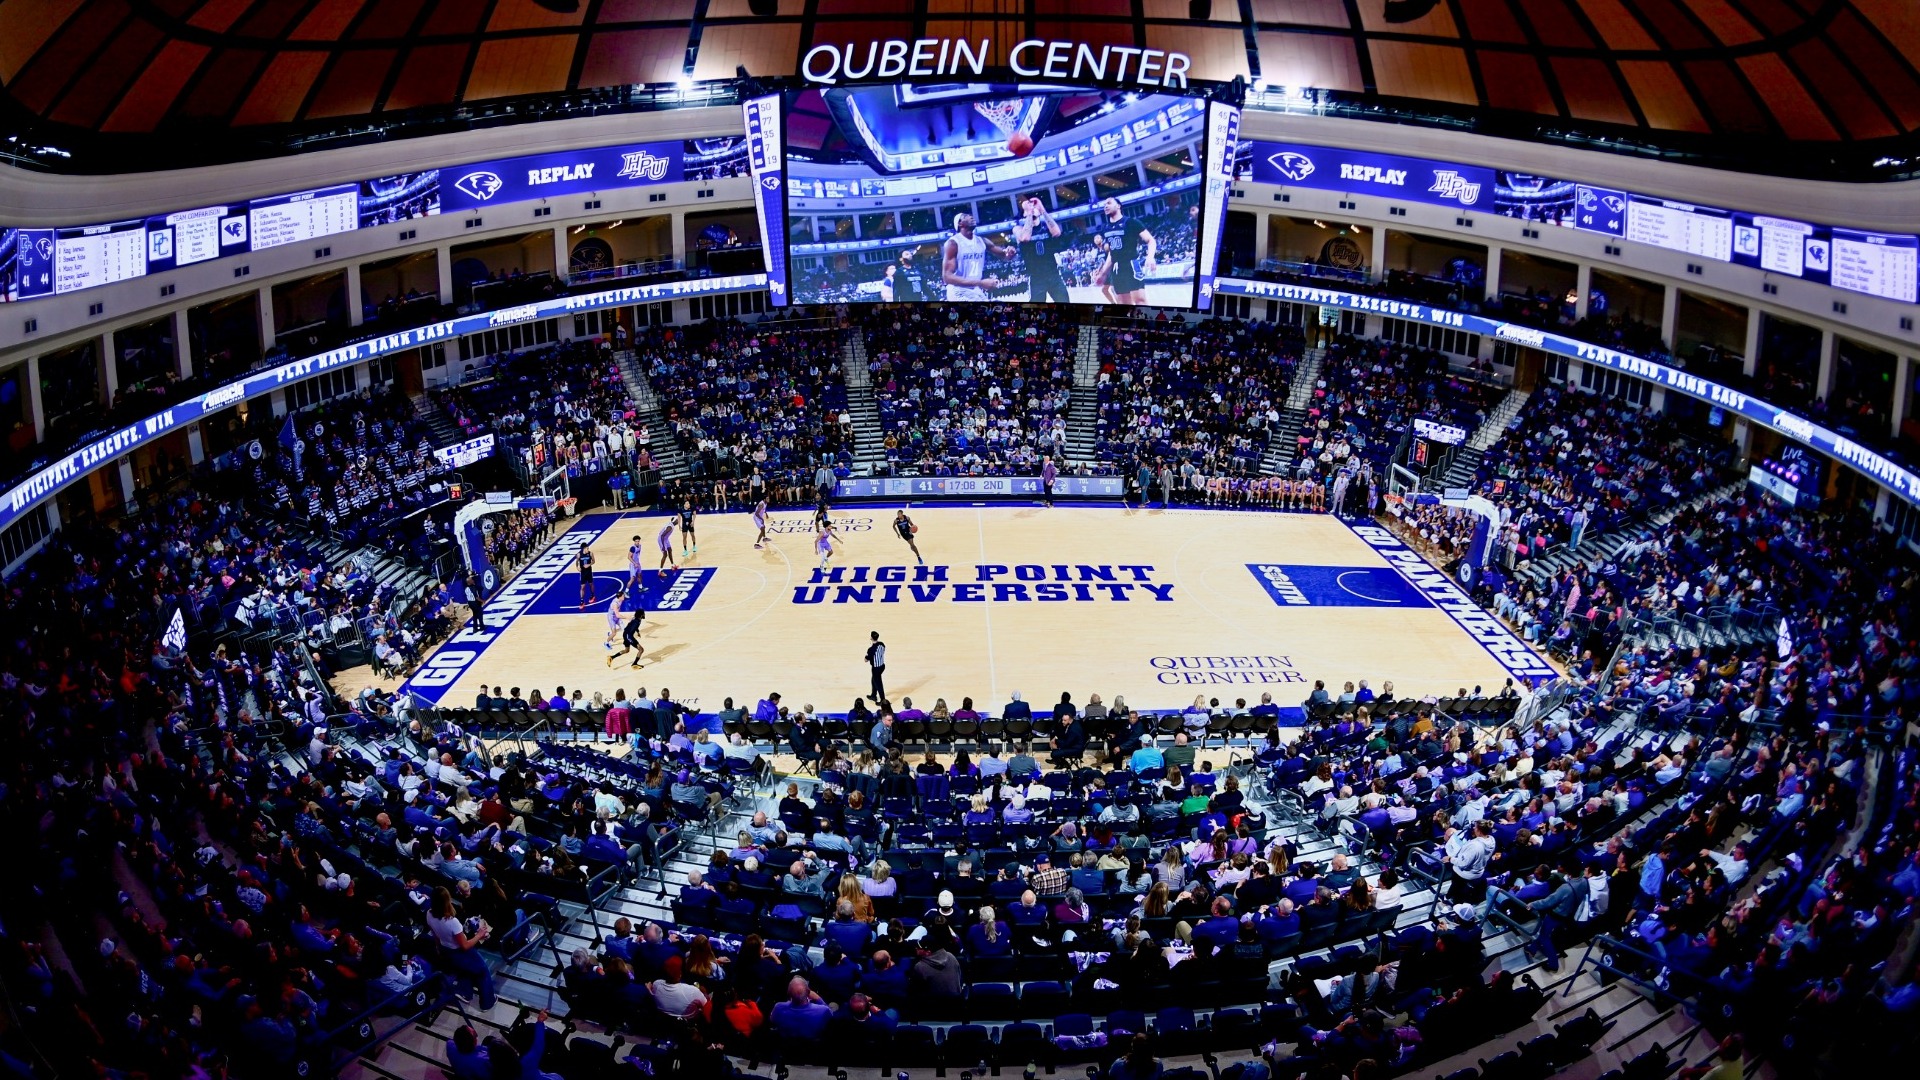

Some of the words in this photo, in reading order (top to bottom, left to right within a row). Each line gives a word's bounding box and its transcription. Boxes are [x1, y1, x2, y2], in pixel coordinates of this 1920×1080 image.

[802, 38, 989, 84] QUBEIN
[1009, 40, 1191, 89] CENTER
[760, 103, 772, 112] 50
[762, 116, 772, 126] 77
[764, 130, 774, 138] 35
[765, 144, 770, 152] 7
[617, 150, 670, 181] HPU
[767, 156, 778, 164] 19
[528, 162, 596, 186] REPLAY
[1340, 163, 1408, 186] REPLAY
[1429, 169, 1481, 205] HPU
[188, 208, 221, 219] COMPARISON
[1583, 215, 1593, 224] 41
[1608, 220, 1619, 230] 44
[22, 275, 30, 287] 41
[40, 273, 49, 285] 44
[565, 287, 666, 310] ANTICIPATE.
[672, 277, 748, 294] EXECUTE.
[1245, 281, 1344, 305] ANTICIPATE.
[1350, 294, 1425, 319] EXECUTE.
[1430, 310, 1464, 327] WIN
[490, 304, 538, 325] Pinnacle
[276, 359, 318, 382] PLAY
[318, 347, 364, 370] HARD,
[369, 333, 412, 354] BANK
[416, 322, 455, 342] EASY
[1576, 342, 1615, 367] PLAY
[1618, 353, 1663, 382] HARD,
[1667, 371, 1707, 395] BANK
[1711, 386, 1747, 410] EASY
[202, 382, 244, 410] Pinnacle
[11, 459, 80, 512] ANTICIPATE.
[82, 429, 142, 467] EXECUTE.
[145, 411, 174, 434] WIN
[1782, 445, 1803, 460] LIVE
[1833, 436, 1905, 490] ANTICIPATE.
[919, 481, 933, 491] 41
[949, 481, 975, 490] 17:08
[983, 480, 1004, 490] 2ND
[1022, 481, 1037, 491] 44
[767, 525, 872, 534] QUEIN
[807, 565, 949, 584] HIGH
[975, 564, 1155, 582] POINT
[1258, 565, 1310, 604] SOUTH
[657, 569, 704, 609] SOUTH
[792, 583, 1176, 605] UNIVERSITY
[1352, 526, 1402, 546] GO
[1380, 549, 1553, 677] PANTHERS!
[410, 650, 476, 687] GO
[1150, 656, 1294, 670] QUBEIN
[1156, 671, 1308, 685] CENTER
